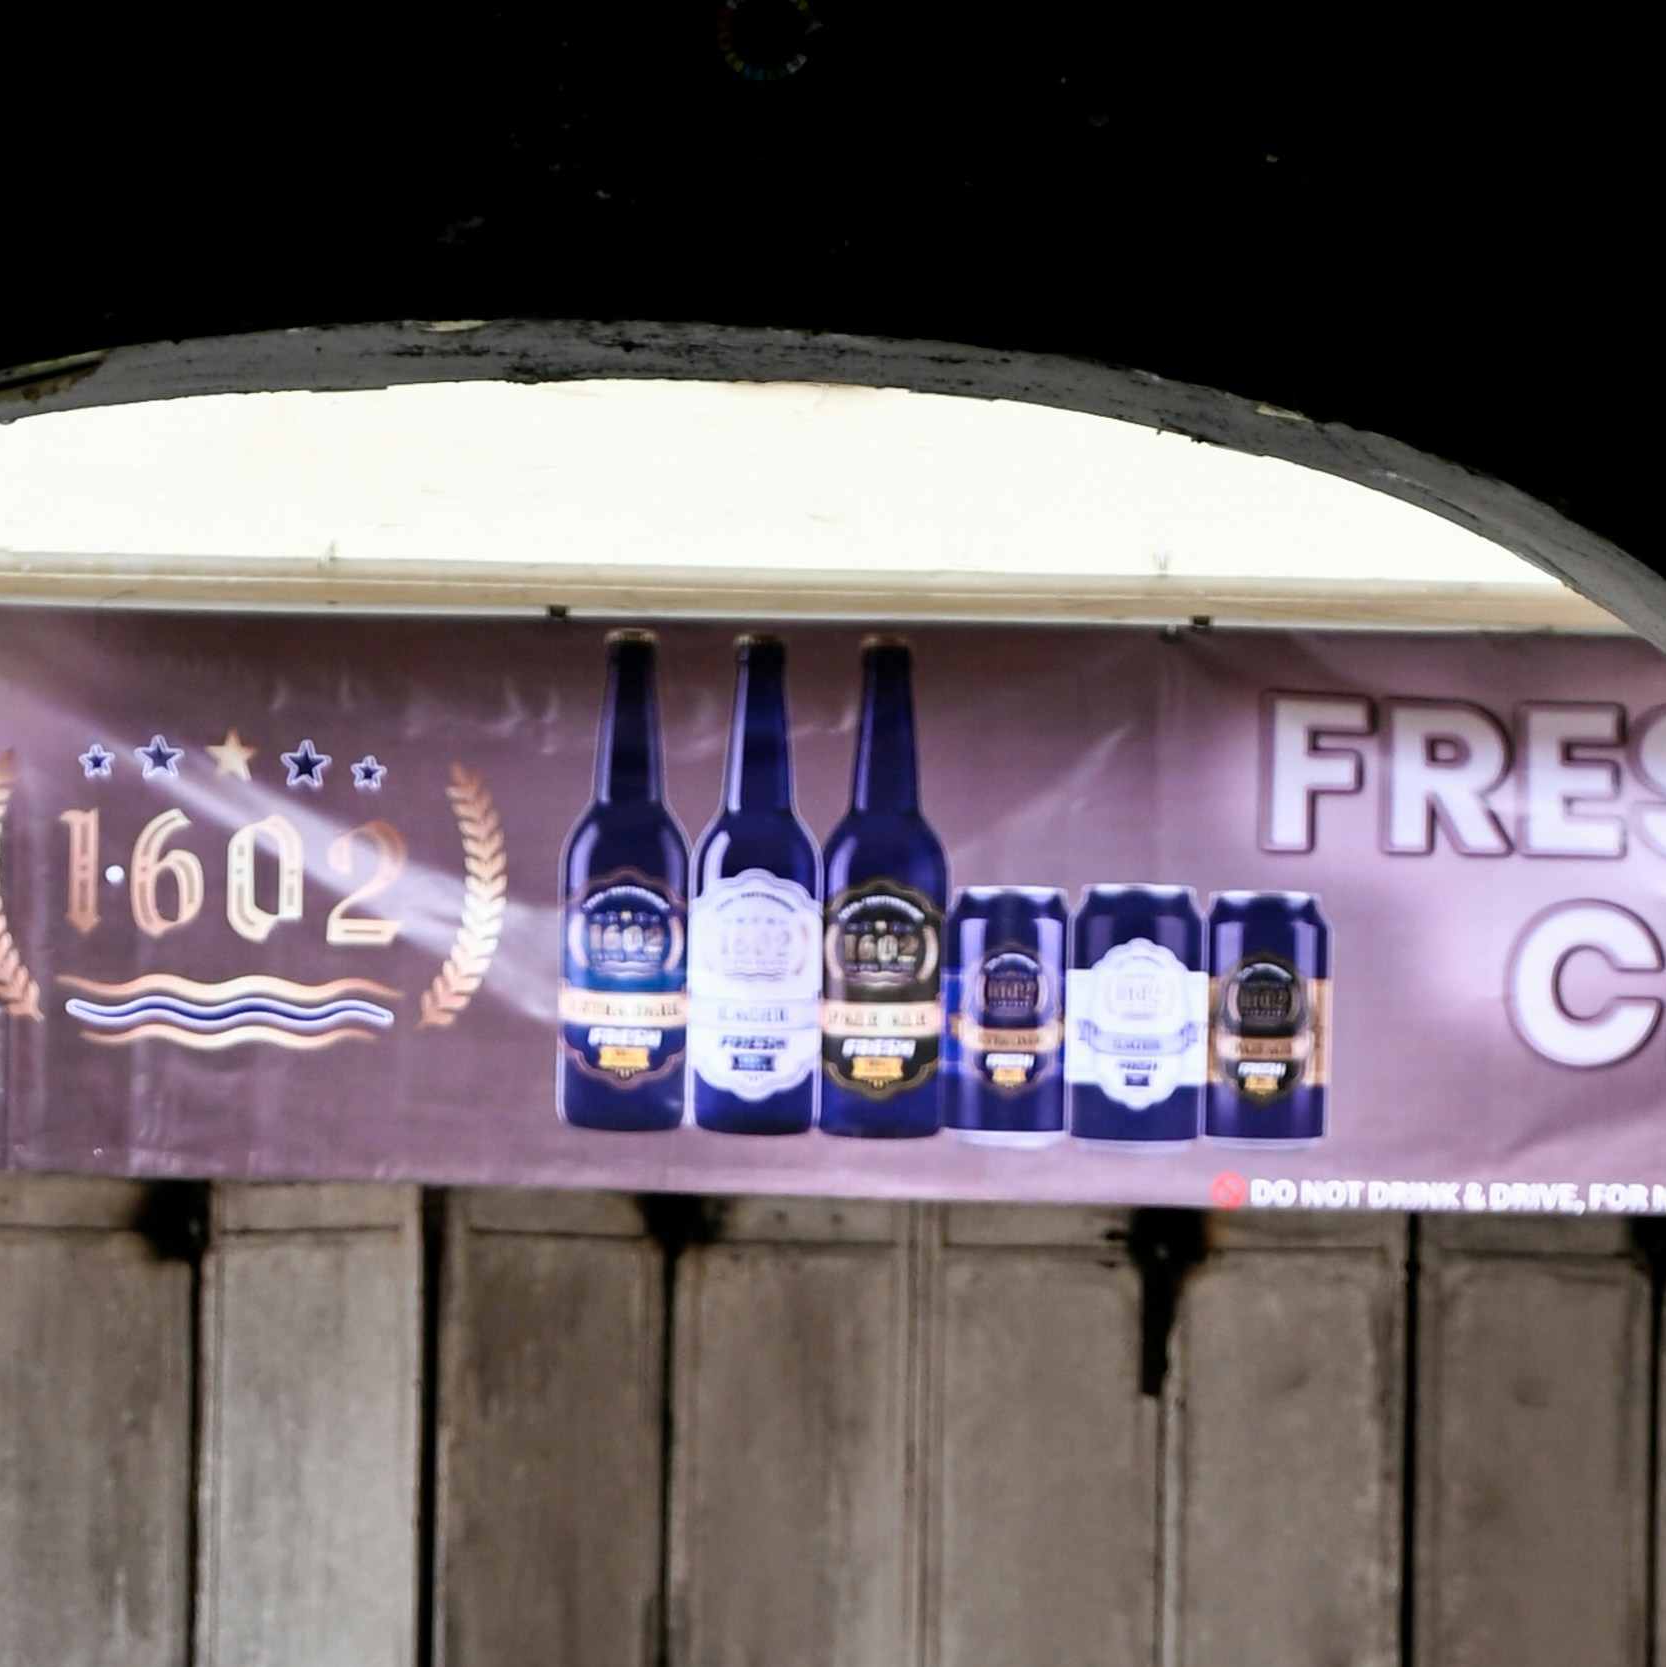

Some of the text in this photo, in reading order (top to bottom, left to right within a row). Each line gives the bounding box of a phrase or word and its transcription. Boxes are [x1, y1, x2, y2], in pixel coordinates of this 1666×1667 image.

[58, 807, 407, 946] 1602
[1250, 1178, 1298, 1209] DO
[1299, 1179, 1366, 1209] NOT
[1367, 1181, 1461, 1211] DRINK
[1463, 1181, 1487, 1212] &
[1489, 1182, 1586, 1215] DRIVE,
[1588, 1183, 1650, 1213] FOR
